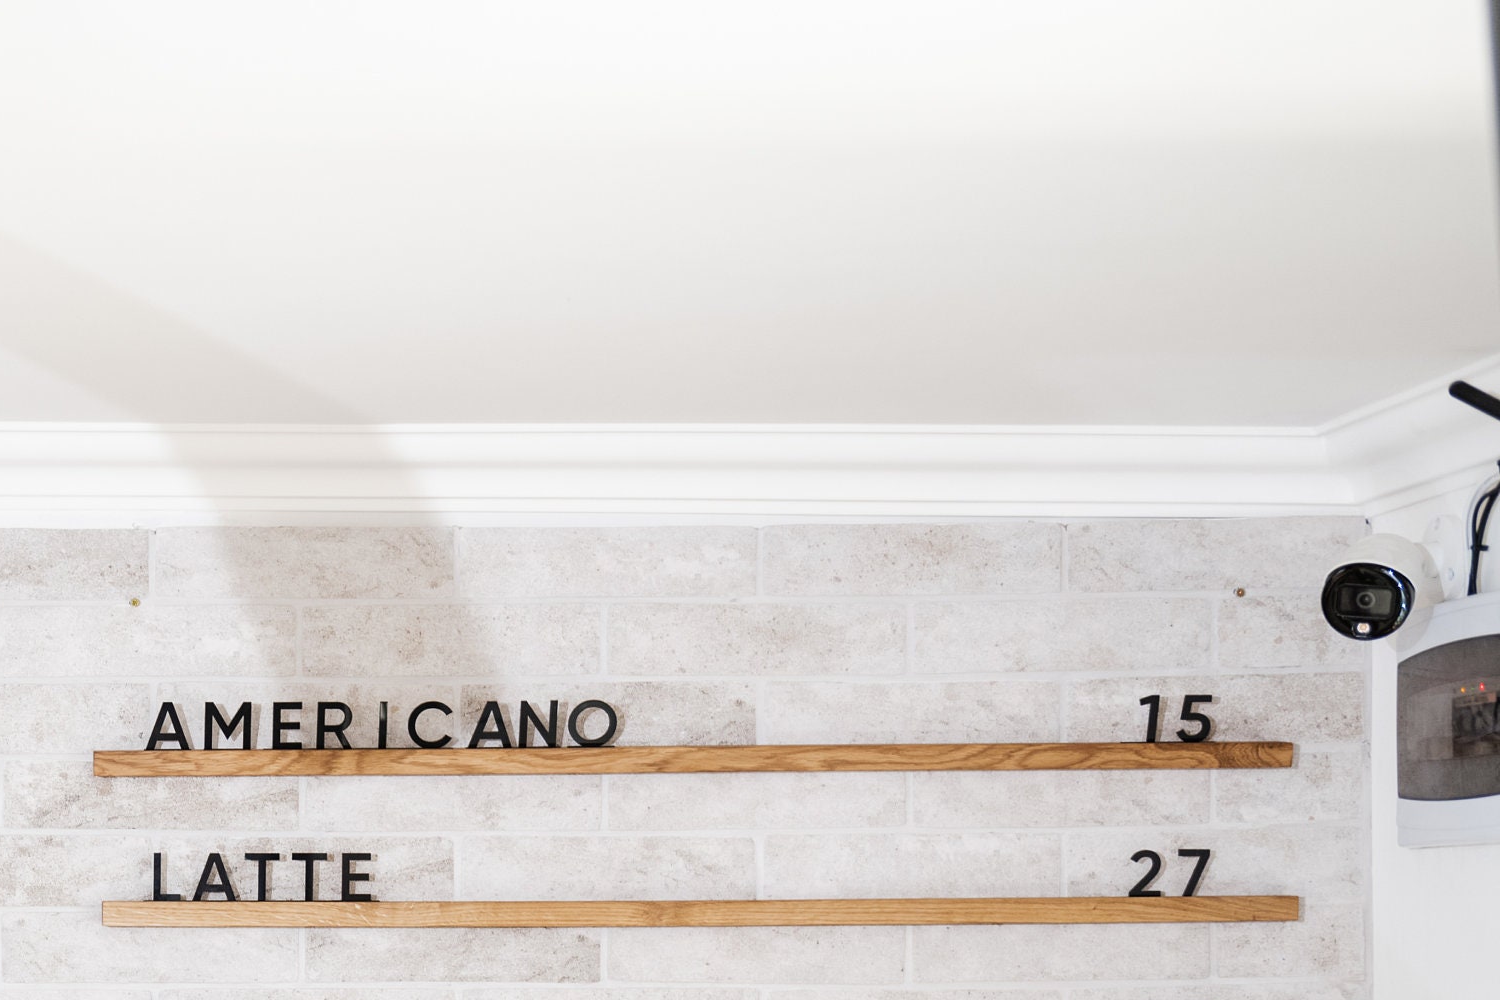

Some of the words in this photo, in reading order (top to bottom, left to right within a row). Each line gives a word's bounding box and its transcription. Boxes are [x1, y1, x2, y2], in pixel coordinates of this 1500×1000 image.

[145, 700, 618, 751] AMERICANO
[1139, 694, 1213, 743] 15
[153, 852, 373, 901] LATTE
[1128, 848, 1211, 897] 27
